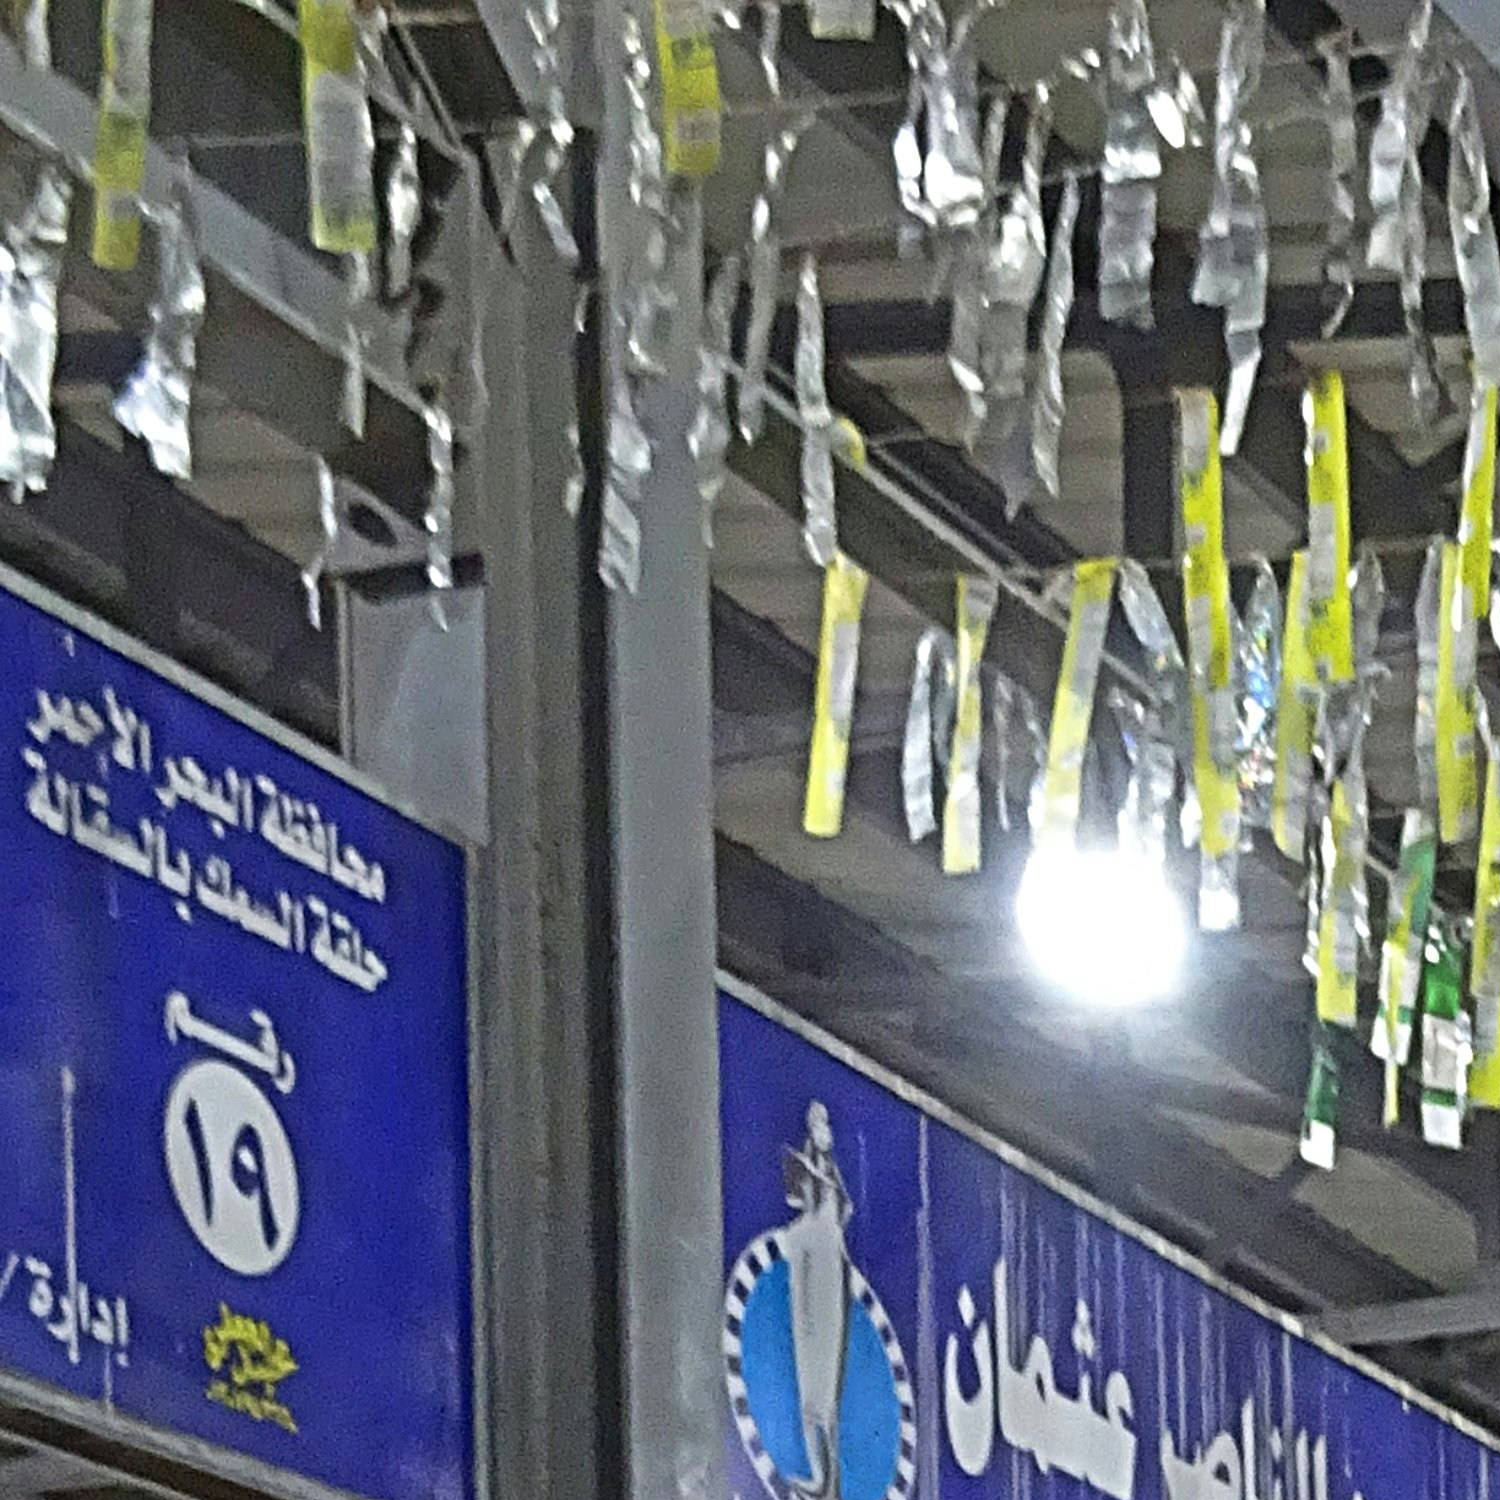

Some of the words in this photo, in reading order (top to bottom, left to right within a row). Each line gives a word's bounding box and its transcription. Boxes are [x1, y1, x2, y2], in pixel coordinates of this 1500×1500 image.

[27, 687, 150, 775] الأحمر
[25, 747, 192, 923] بالسقالة
[156, 745, 254, 833] البحر
[258, 773, 387, 903] محافظة
[195, 851, 305, 953] السمك
[309, 893, 388, 992] حلقة
[166, 989, 296, 1093] رقم
[183, 1096, 279, 1256] ١٩
[25, 1255, 129, 1367] إدارة
